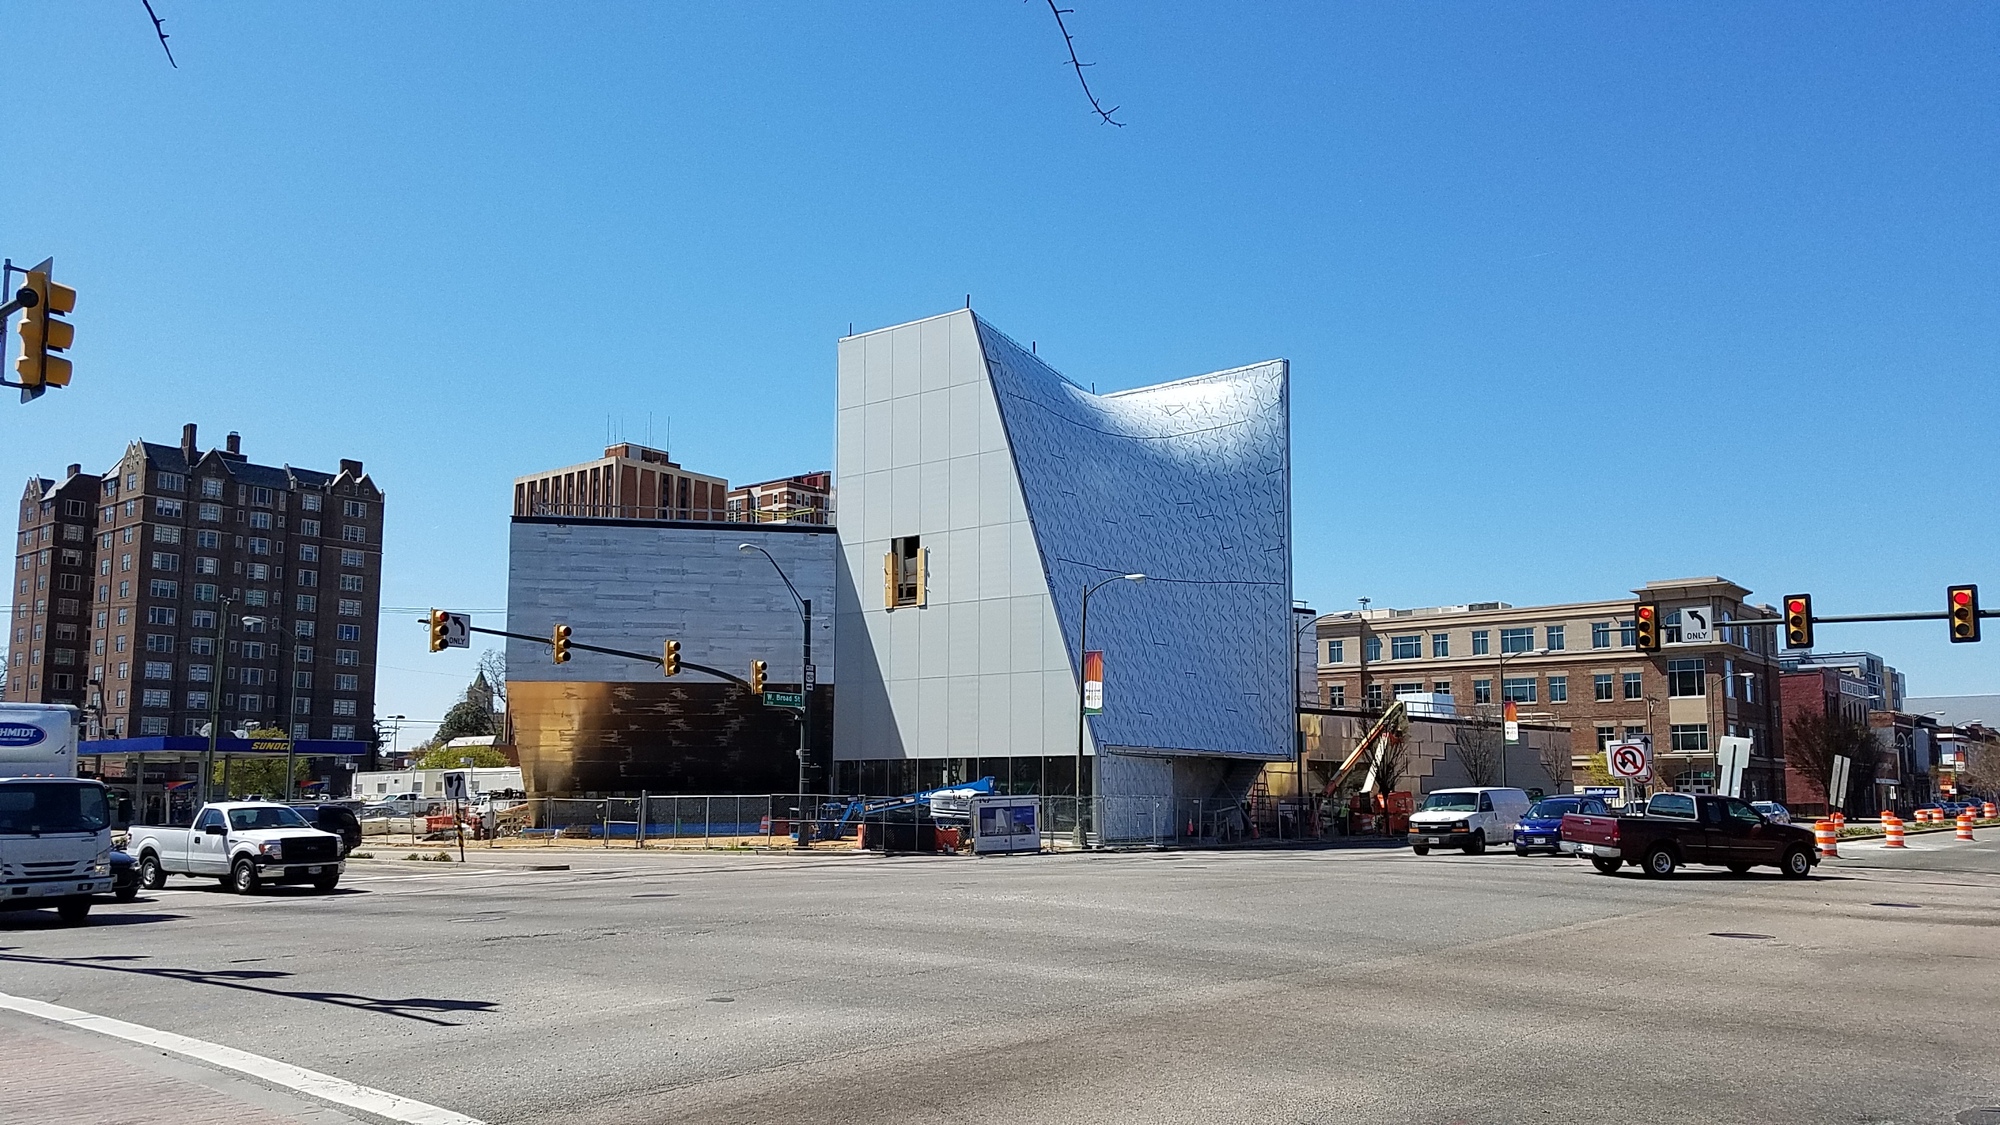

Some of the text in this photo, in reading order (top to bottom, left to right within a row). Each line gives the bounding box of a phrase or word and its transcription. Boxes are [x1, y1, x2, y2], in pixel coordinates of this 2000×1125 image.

[1686, 631, 1707, 639] ONLY
[449, 636, 465, 645] ONLY
[766, 693, 775, 701] W.
[776, 694, 793, 702] Broad
